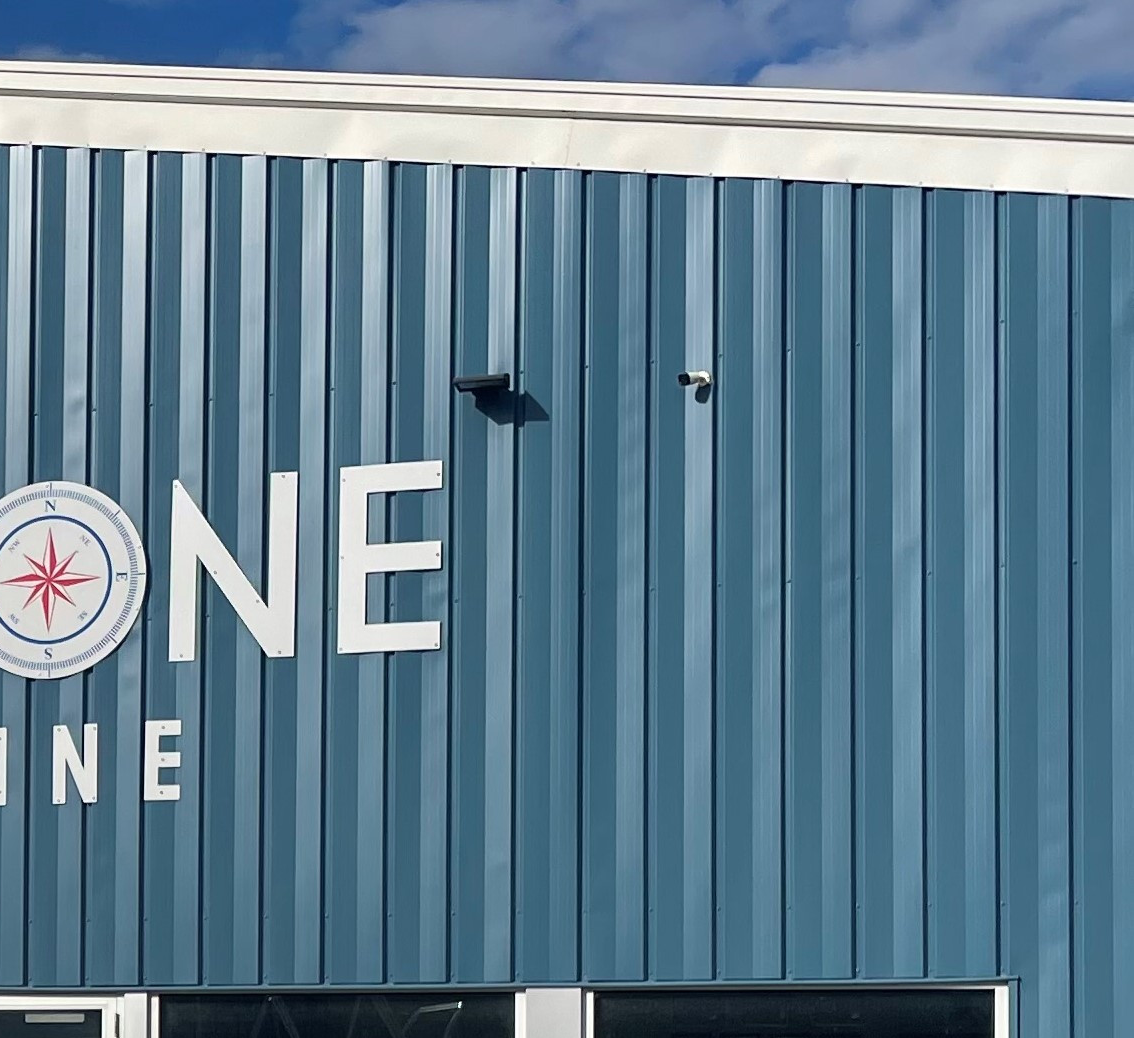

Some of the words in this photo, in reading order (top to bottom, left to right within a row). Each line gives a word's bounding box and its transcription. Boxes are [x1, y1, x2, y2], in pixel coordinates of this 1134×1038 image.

[45, 500, 56, 512] N
[116, 572, 127, 582] E
[44, 648, 53, 660] S
